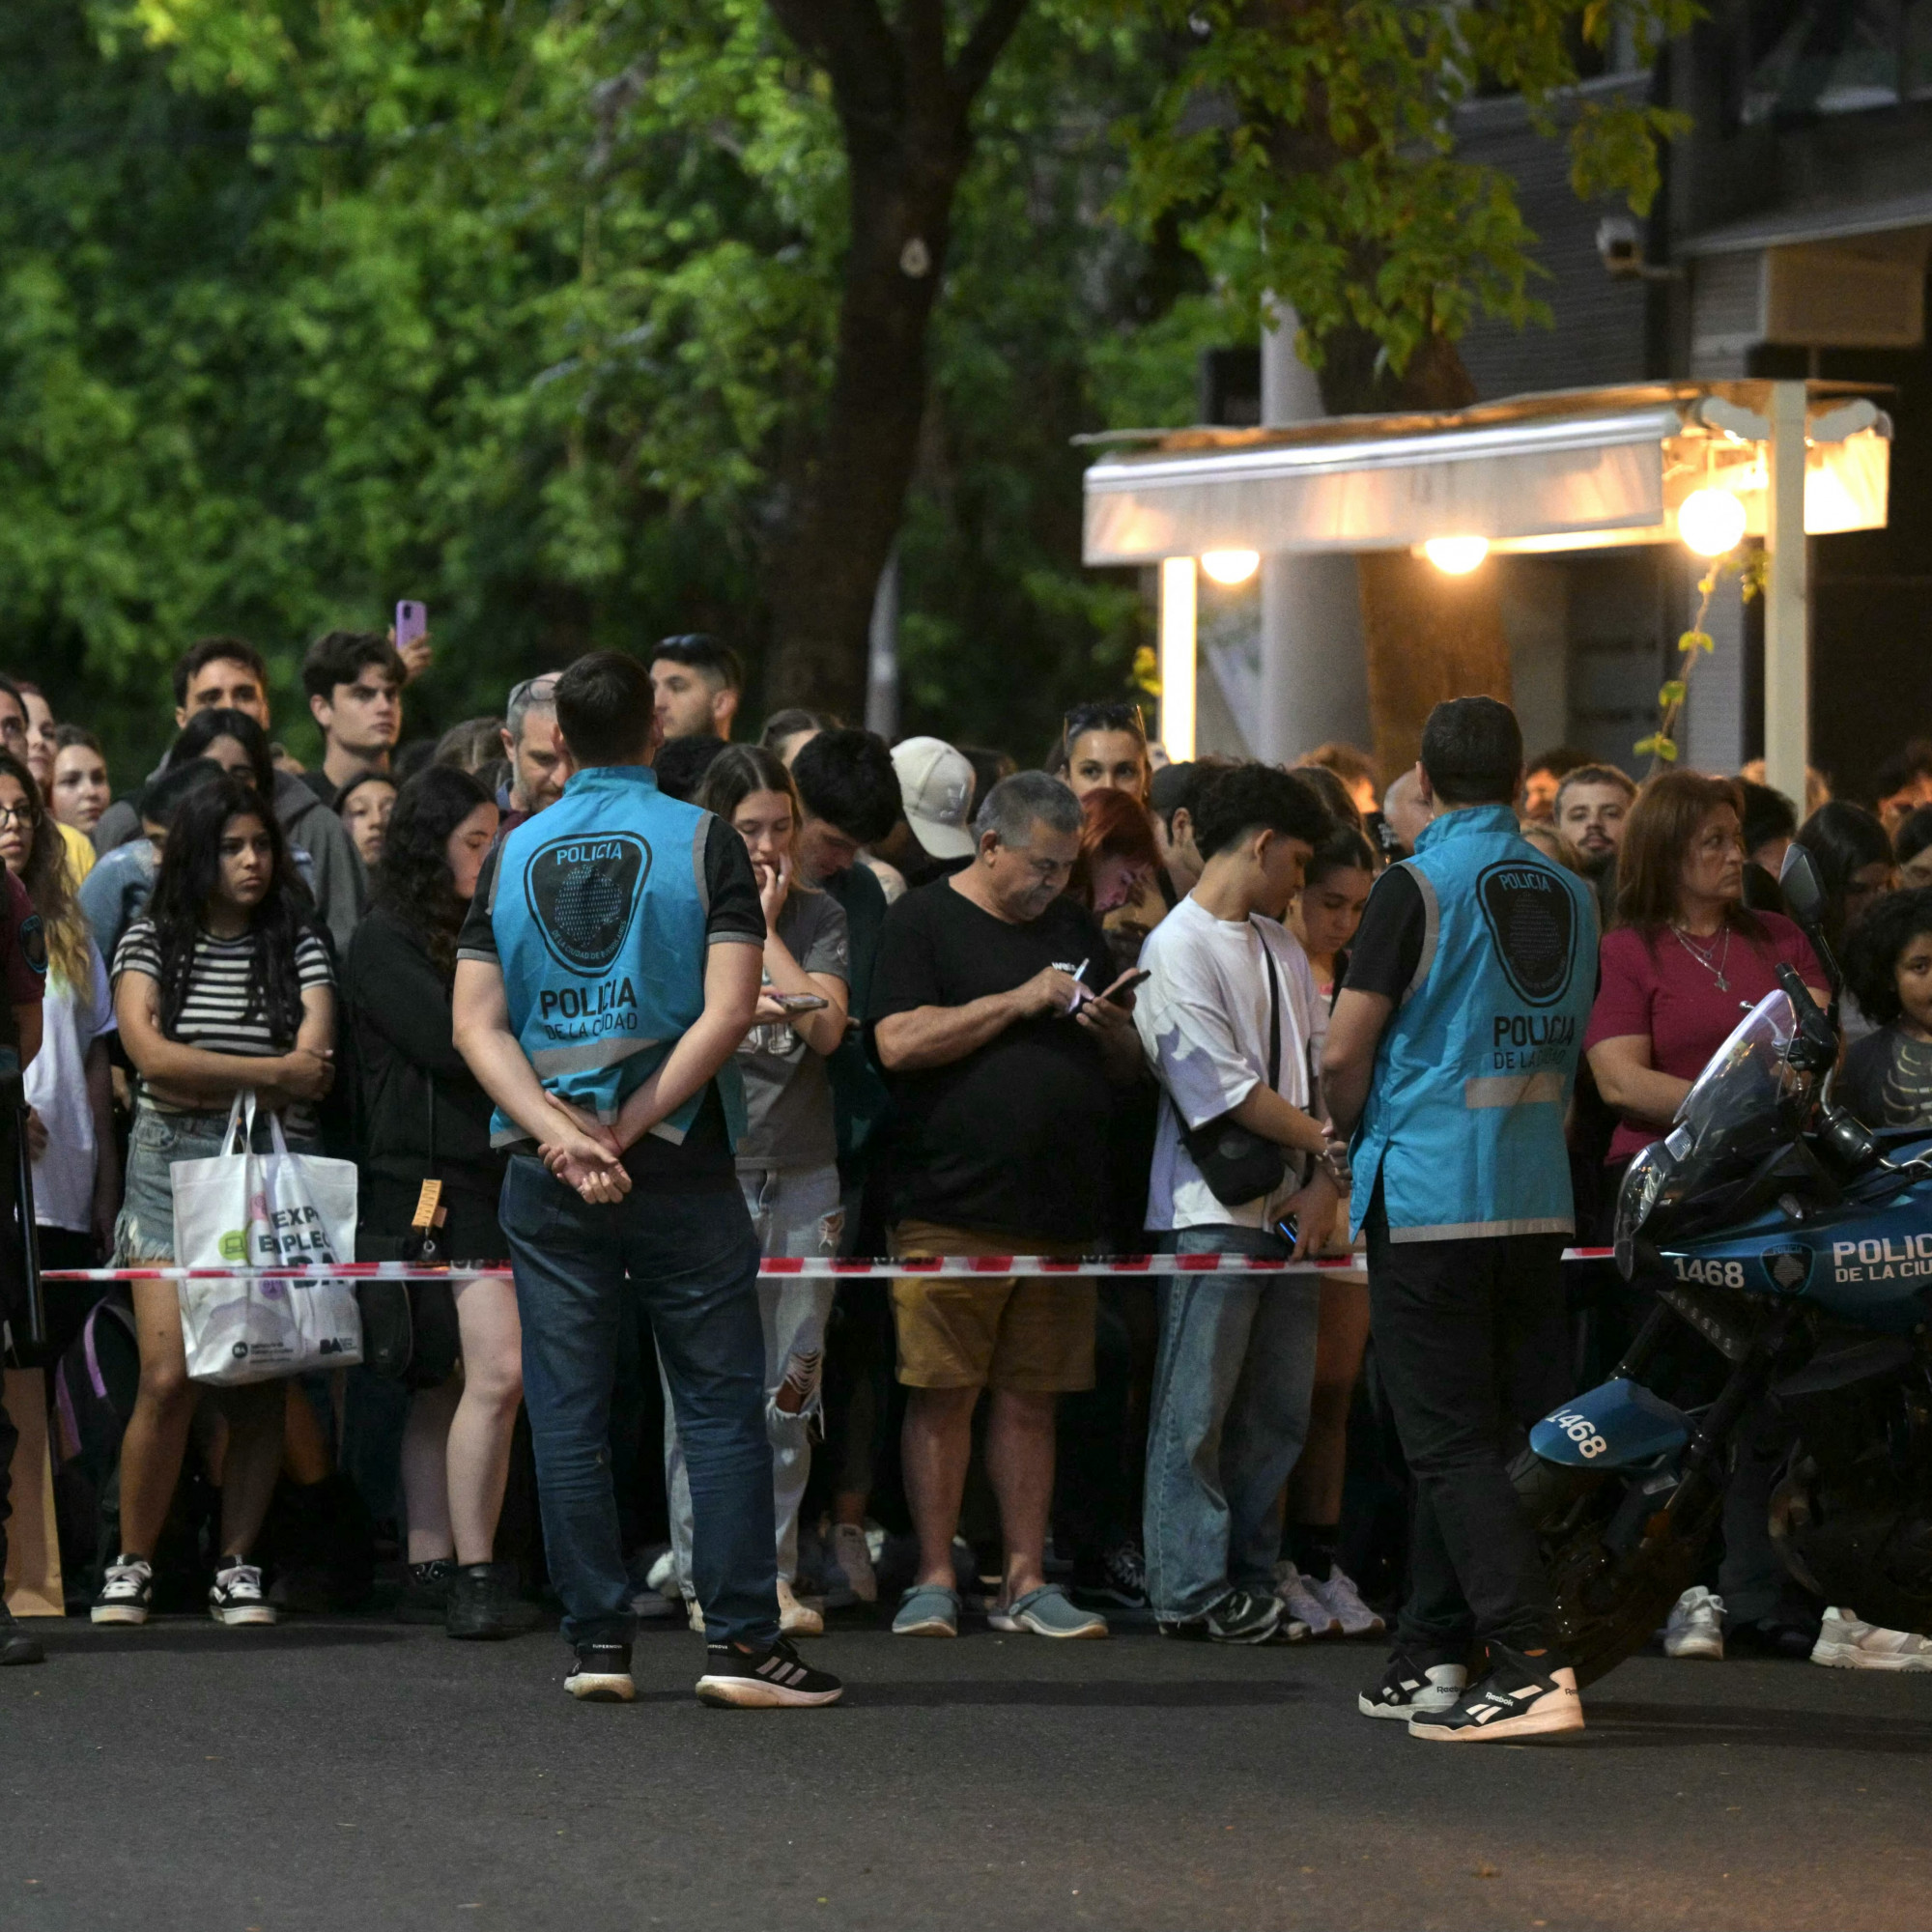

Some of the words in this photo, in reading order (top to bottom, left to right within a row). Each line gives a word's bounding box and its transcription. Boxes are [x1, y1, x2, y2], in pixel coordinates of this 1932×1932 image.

[556, 842, 622, 866] POLICIA
[1498, 873, 1551, 894] POLICIA
[540, 977, 638, 1020] POLICIA
[544, 1024, 566, 1040] DE
[568, 1022, 588, 1039] LA
[1493, 1052, 1515, 1069] DE
[270, 1206, 319, 1230] EXP
[1673, 1257, 1745, 1289] 1468
[1835, 1266, 1863, 1283] DE
[1869, 1264, 1895, 1280] LA
[1545, 1408, 1607, 1459] 1468
[1485, 1691, 1514, 1707] Reebok
